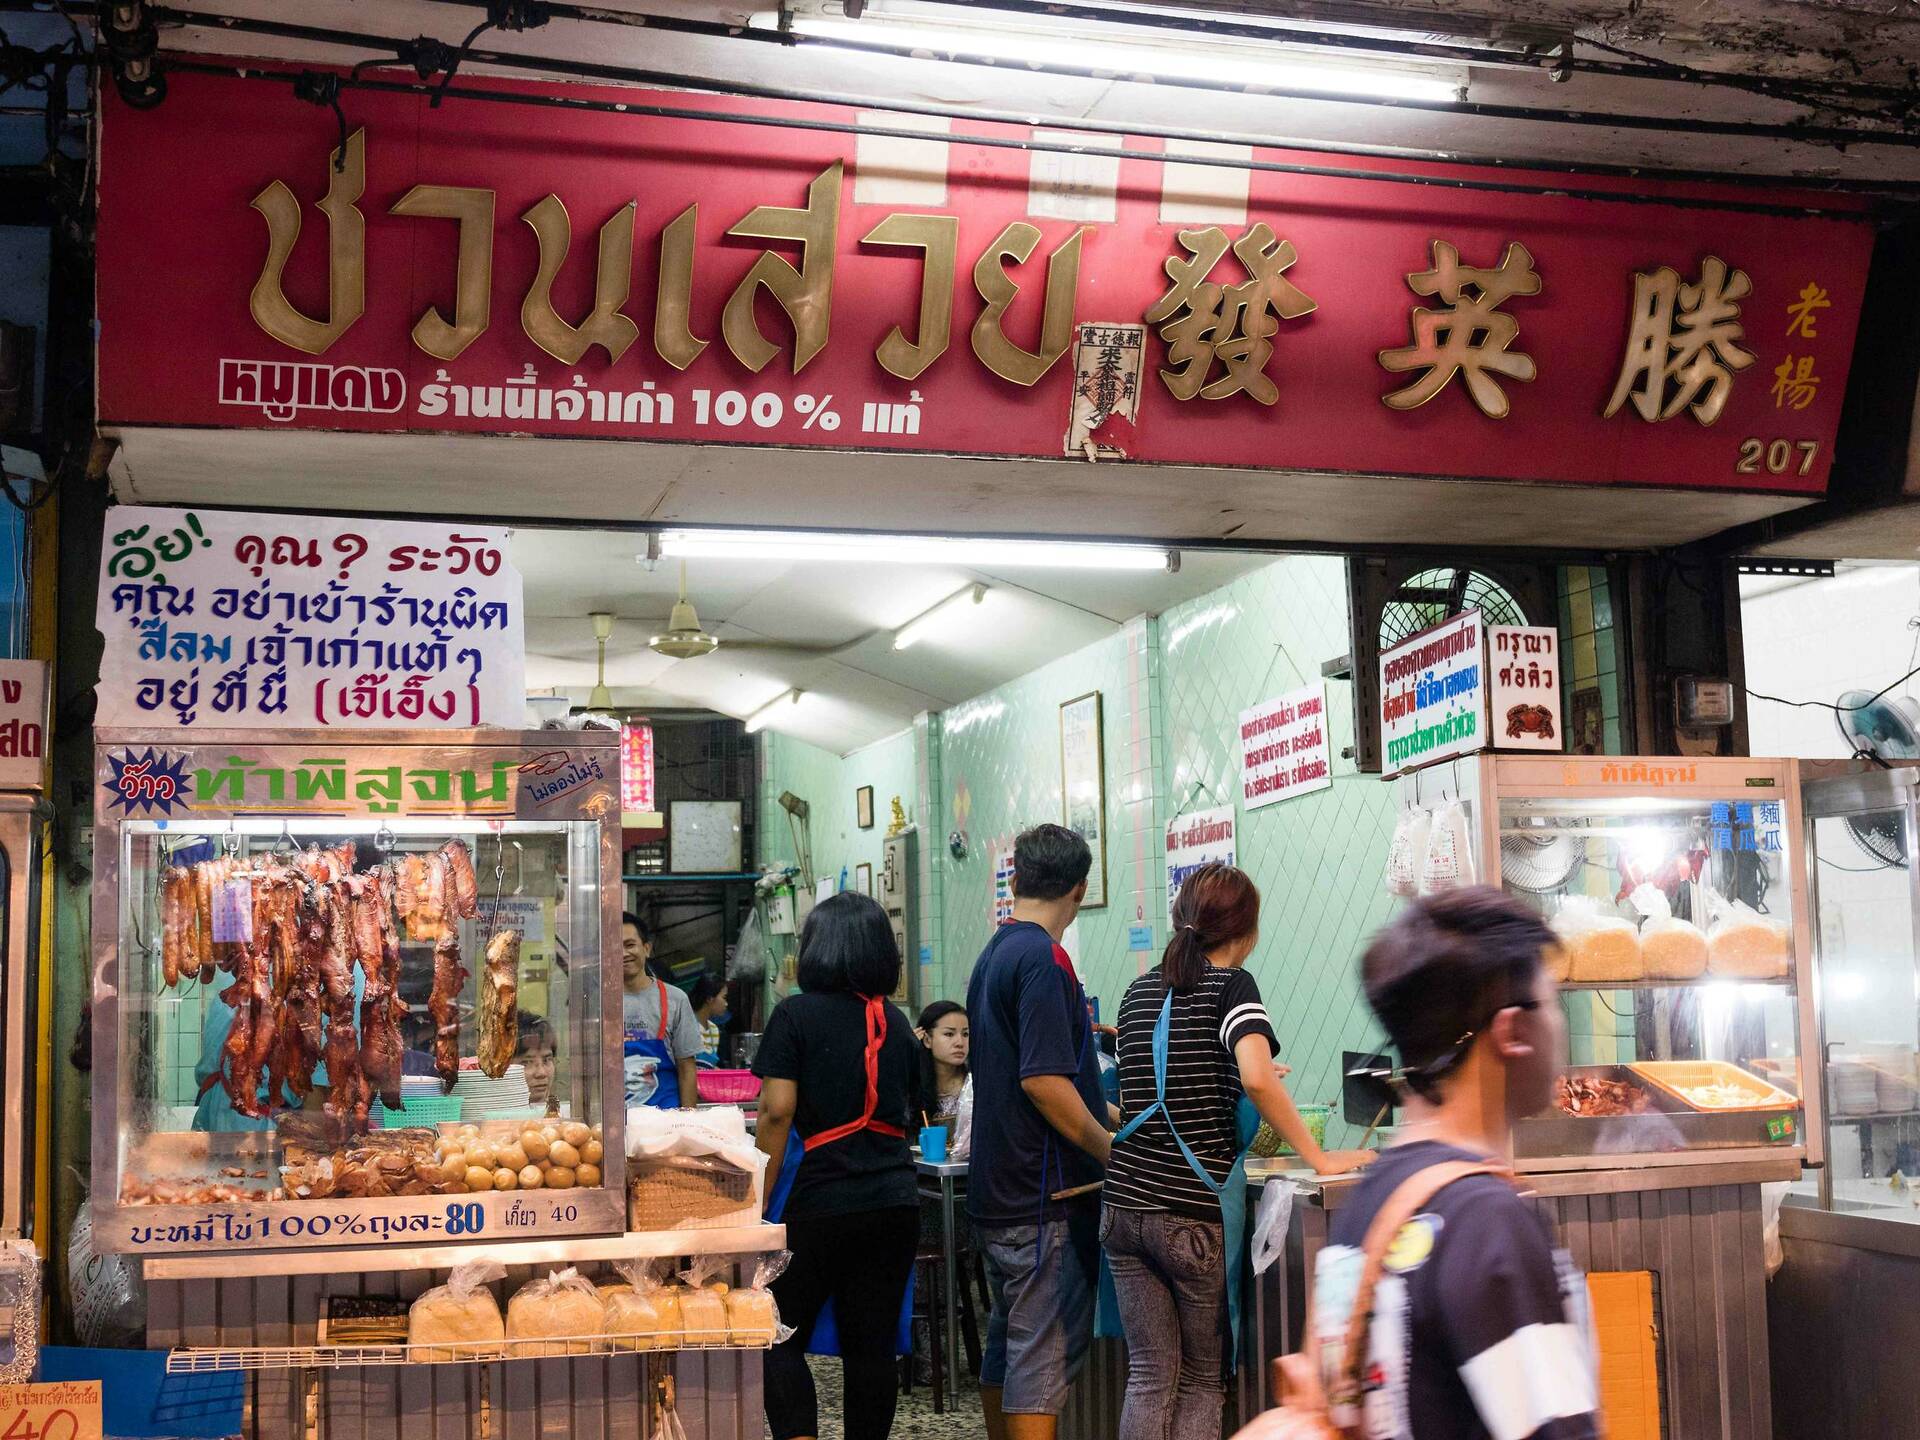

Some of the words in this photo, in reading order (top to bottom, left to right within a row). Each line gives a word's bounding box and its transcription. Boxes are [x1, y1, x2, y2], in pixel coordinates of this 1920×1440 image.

[219, 358, 406, 422] หมูแดง
[417, 363, 674, 425] ร้านนี้เจ้าเก่า
[862, 390, 921, 435] แท้
[1735, 438, 1820, 477] 207
[109, 513, 212, 586] อุ๊ย!
[388, 533, 502, 577] ระวัง
[112, 582, 195, 626] คุณ
[211, 579, 509, 631] อย่าเข้าร้านผิด
[138, 616, 232, 664] สีลม
[1496, 632, 1552, 660] กรุณา
[1499, 661, 1553, 690] ต่อคิว
[193, 755, 519, 813] ท้าพิสูจน์
[525, 756, 604, 801] ไม่ลองไม่รู้
[1600, 761, 1697, 787] ท้าพิสูจน์
[445, 1202, 485, 1235] 80
[505, 1199, 537, 1226] เกี๊ยว
[551, 1205, 578, 1222] 40
